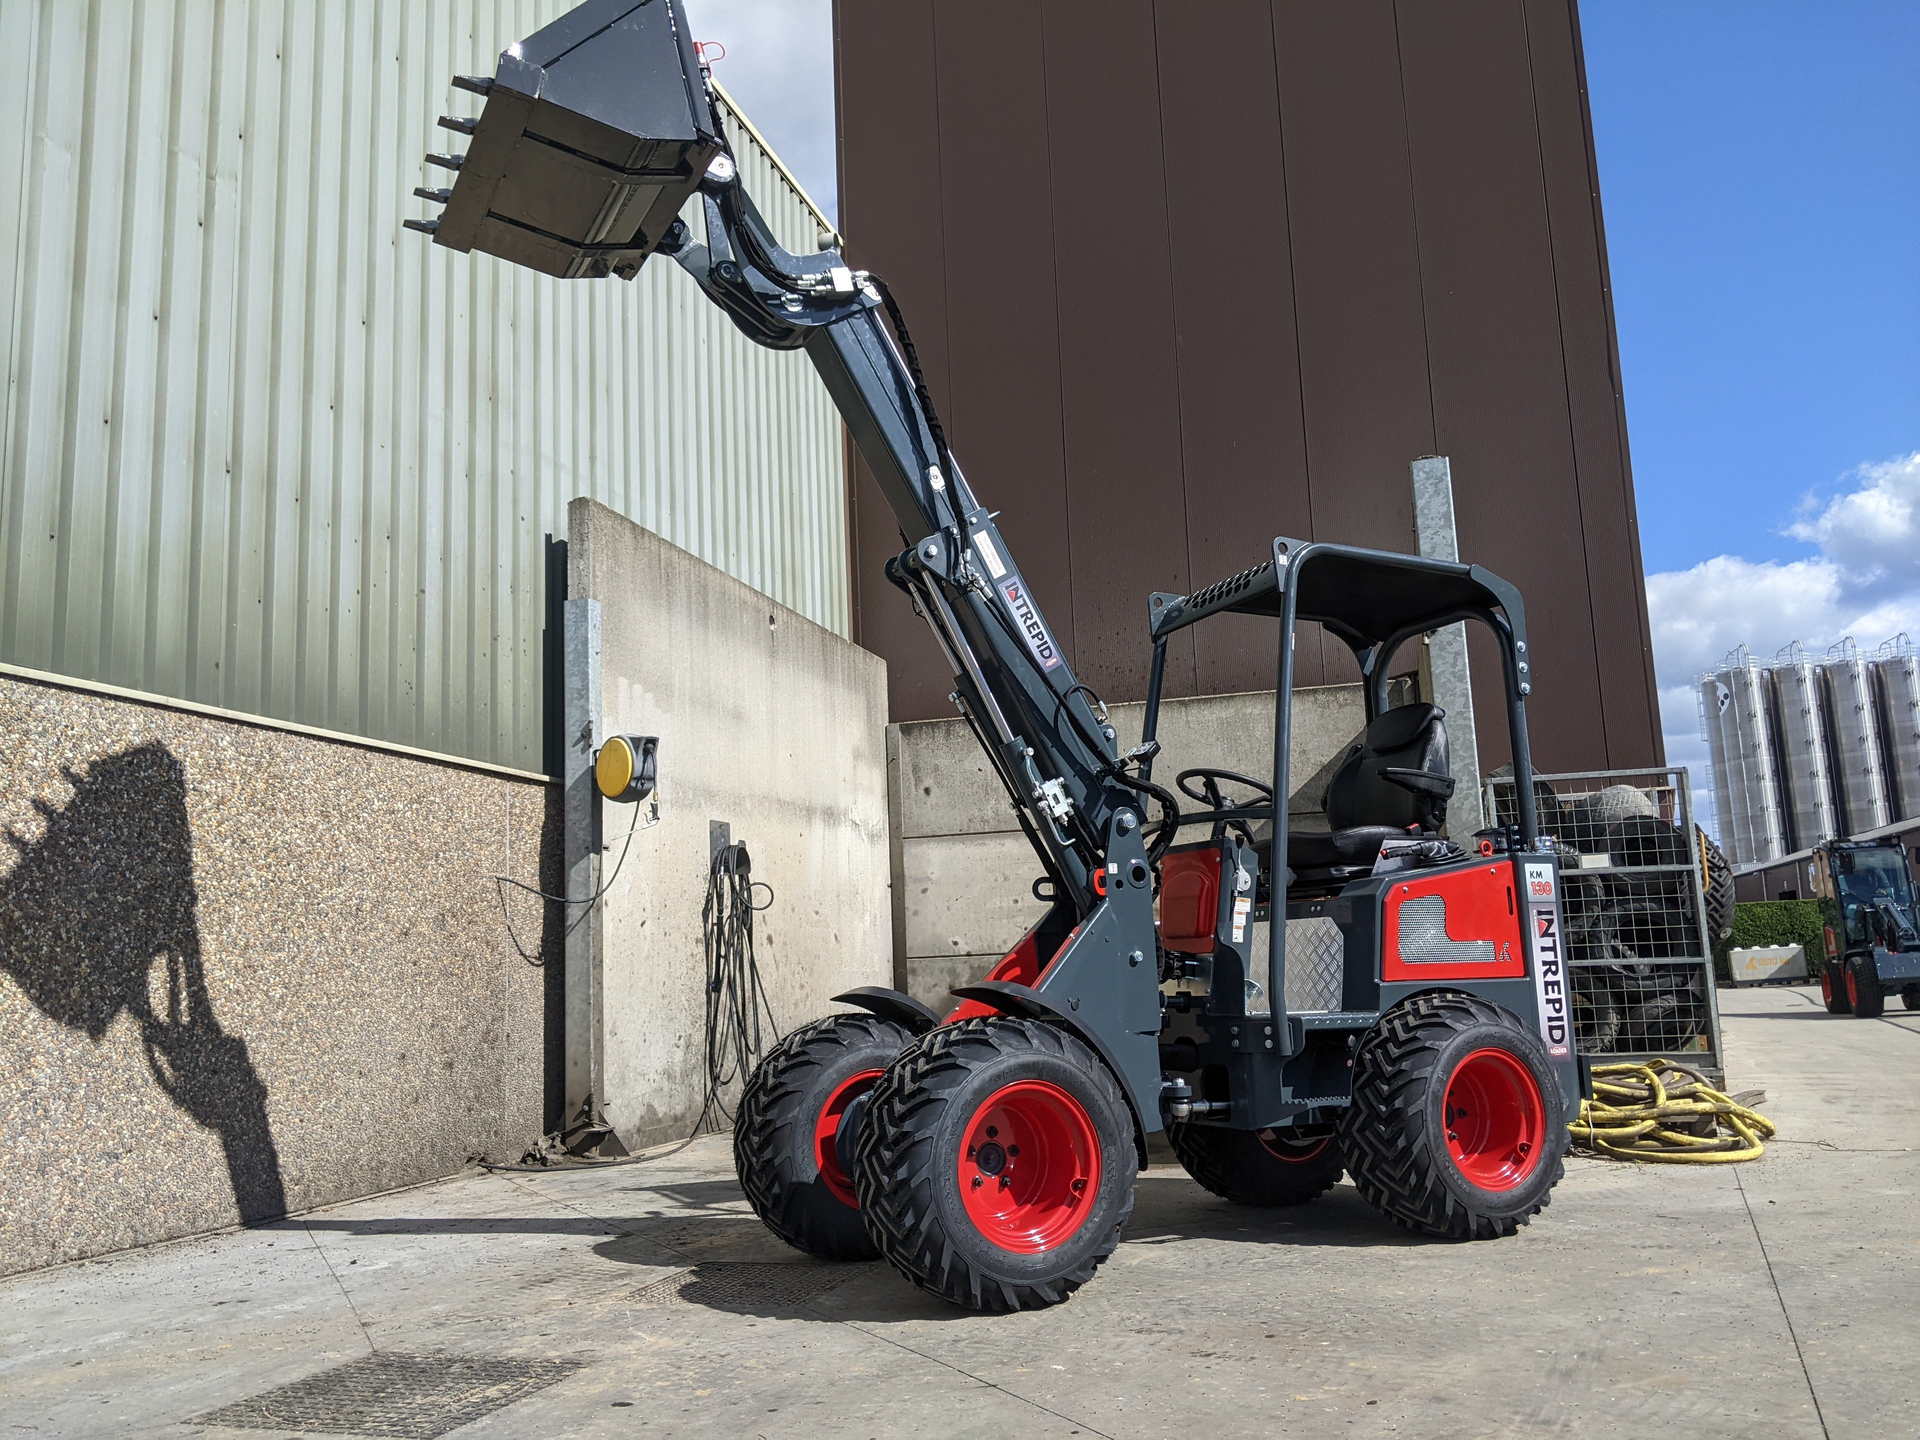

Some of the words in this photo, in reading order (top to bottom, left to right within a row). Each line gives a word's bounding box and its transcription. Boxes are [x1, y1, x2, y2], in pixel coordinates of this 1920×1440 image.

[1004, 581, 1053, 660] INTREPID
[1529, 870, 1543, 879] KM
[1531, 881, 1553, 896] 130
[1537, 910, 1566, 1045] INTREPID
